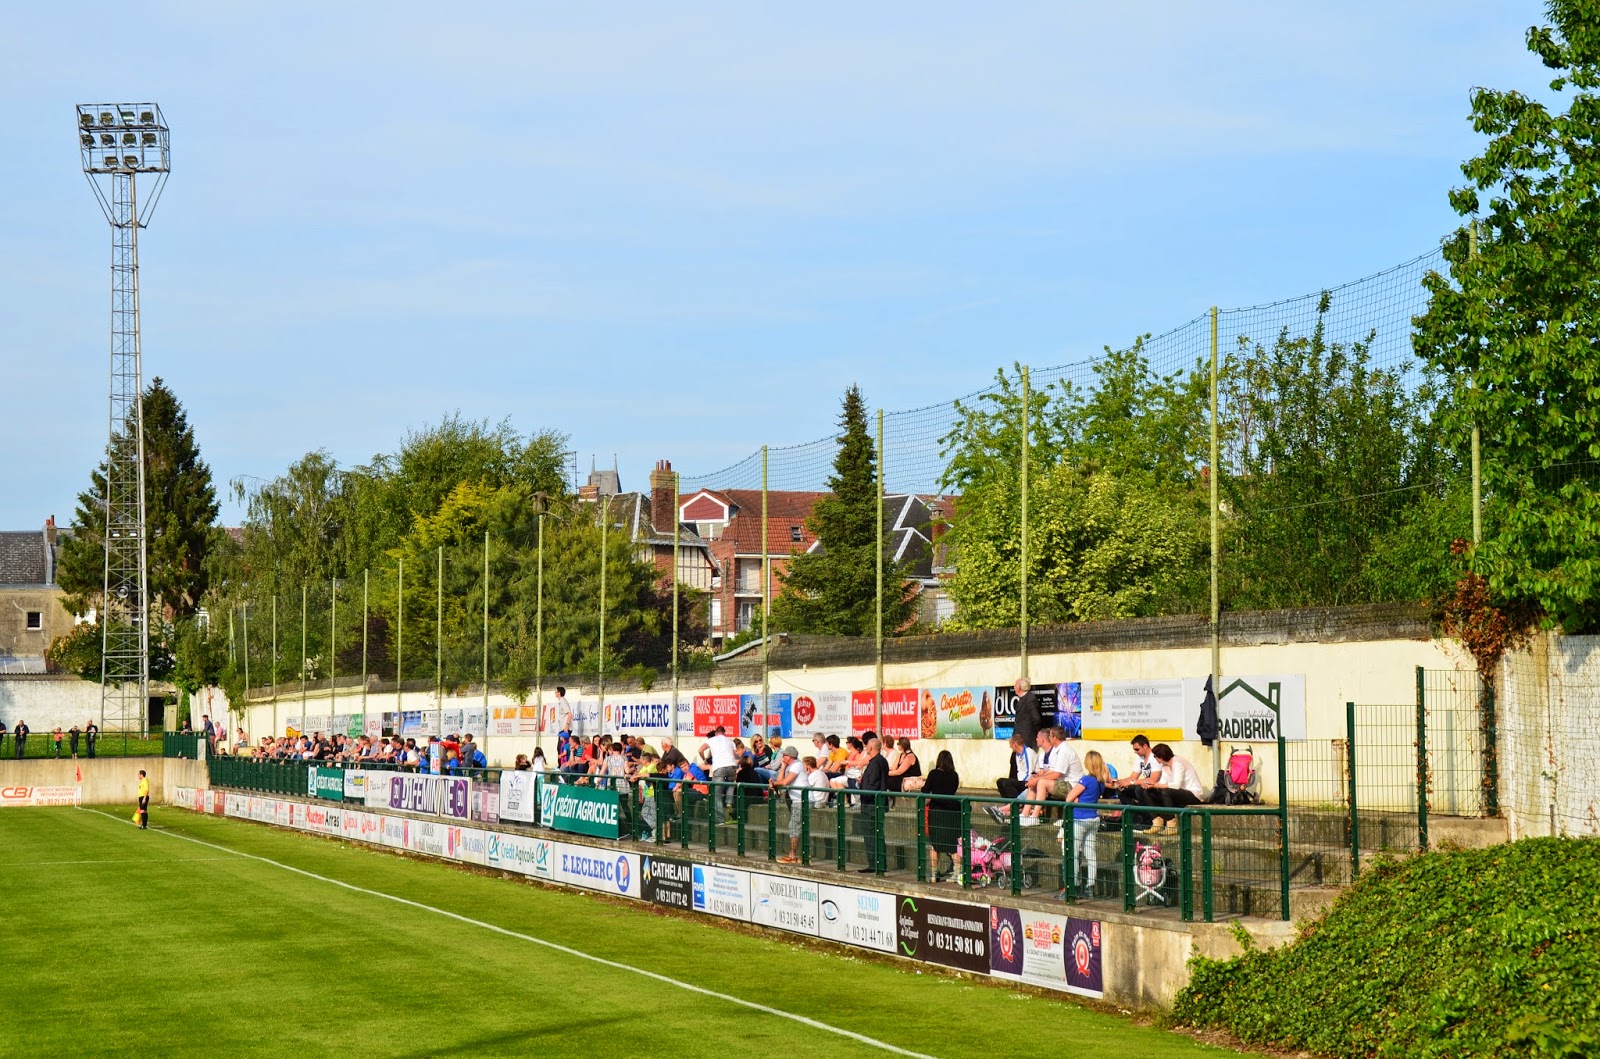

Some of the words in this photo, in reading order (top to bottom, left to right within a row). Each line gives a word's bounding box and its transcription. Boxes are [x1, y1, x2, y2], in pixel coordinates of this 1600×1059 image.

[695, 697, 710, 714] ARRAS
[853, 699, 874, 716] flunch
[621, 704, 669, 728] E.LECLERC
[676, 722, 694, 732] AINVILLE
[555, 794, 577, 818] CRÉDIT
[578, 801, 618, 825] AGRICOLE
[325, 811, 340, 828] Arras
[502, 840, 514, 860] Crédit
[515, 848, 535, 866] Agricole
[562, 854, 613, 881] E.LECLERC
[651, 861, 690, 883] CATHELAIN
[770, 881, 798, 899] SODELEM
[1033, 921, 1038, 929] LE
[852, 925, 860, 940] 03
[861, 927, 868, 941] 21
[869, 929, 876, 943] 44
[877, 930, 885, 944] 71
[885, 932, 894, 947] 68
[1034, 930, 1051, 940] BURGER
[936, 932, 944, 949] 03
[945, 934, 953, 951] 21
[954, 936, 964, 953] 50
[964, 938, 973, 955] 81
[974, 939, 984, 957] 00
[1034, 939, 1052, 950] OFFERT
